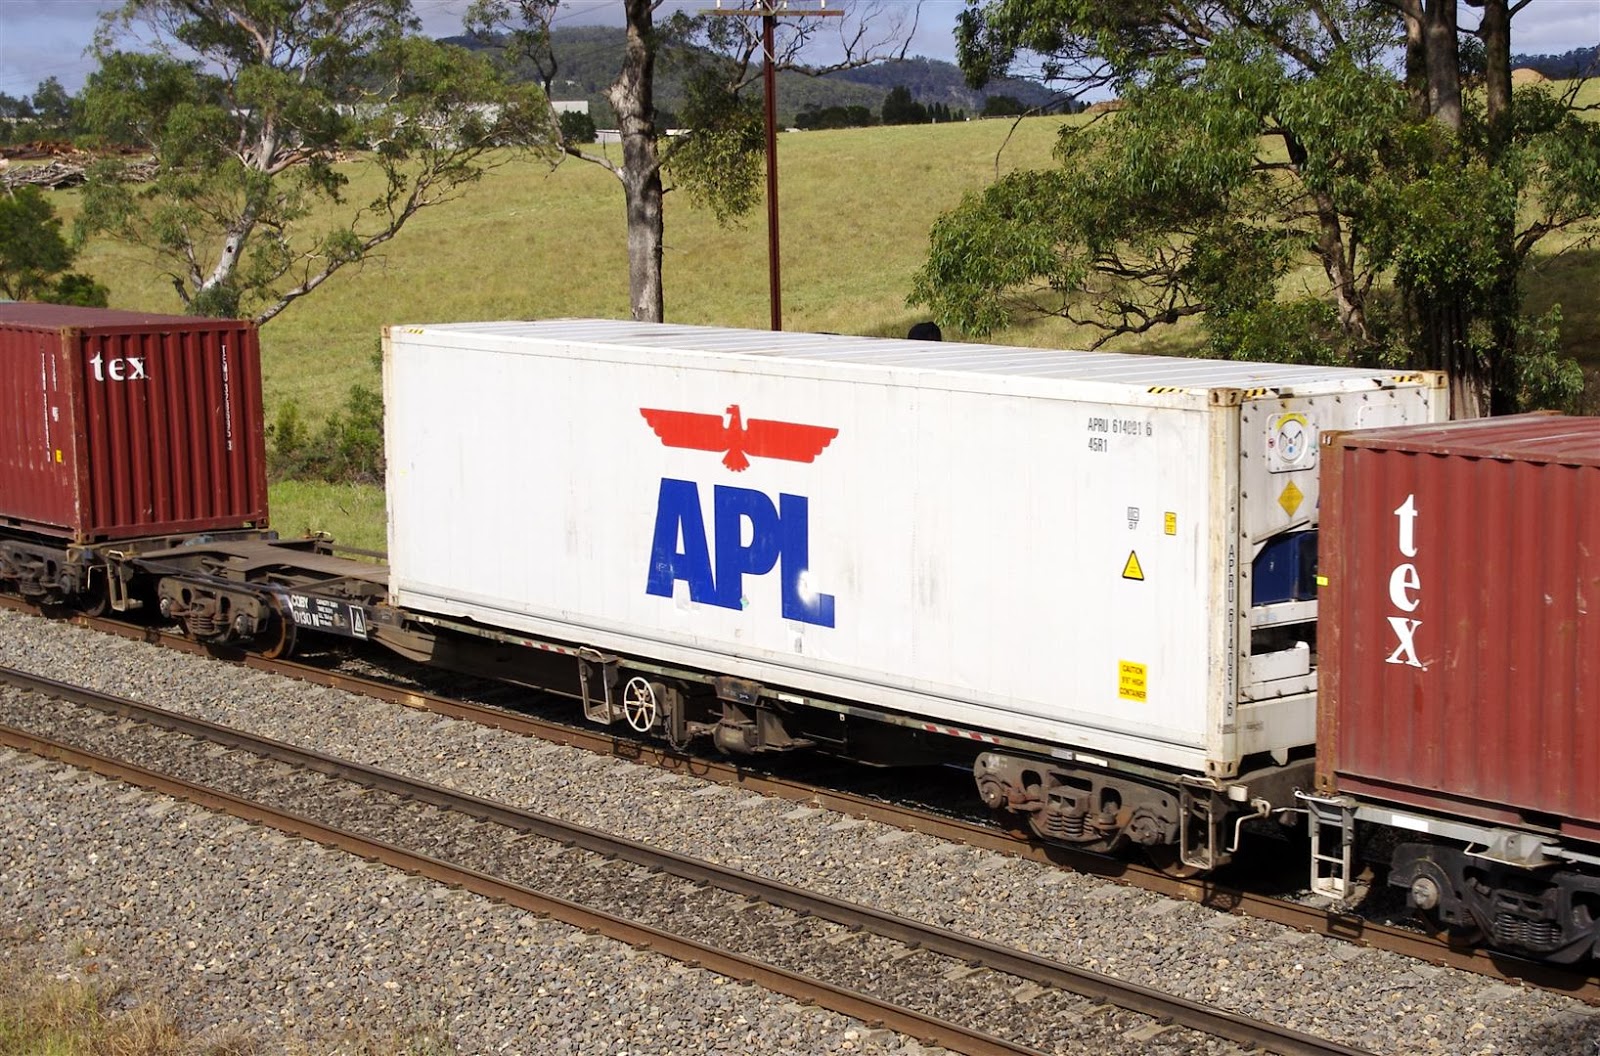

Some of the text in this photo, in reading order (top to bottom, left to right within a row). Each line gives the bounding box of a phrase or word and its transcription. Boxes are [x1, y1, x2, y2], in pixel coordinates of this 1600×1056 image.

[89, 351, 148, 381] tex
[1088, 417, 1109, 433] APRU
[1088, 437, 1108, 453] 45R1
[646, 477, 835, 628] APL
[1227, 544, 1236, 603] APRU
